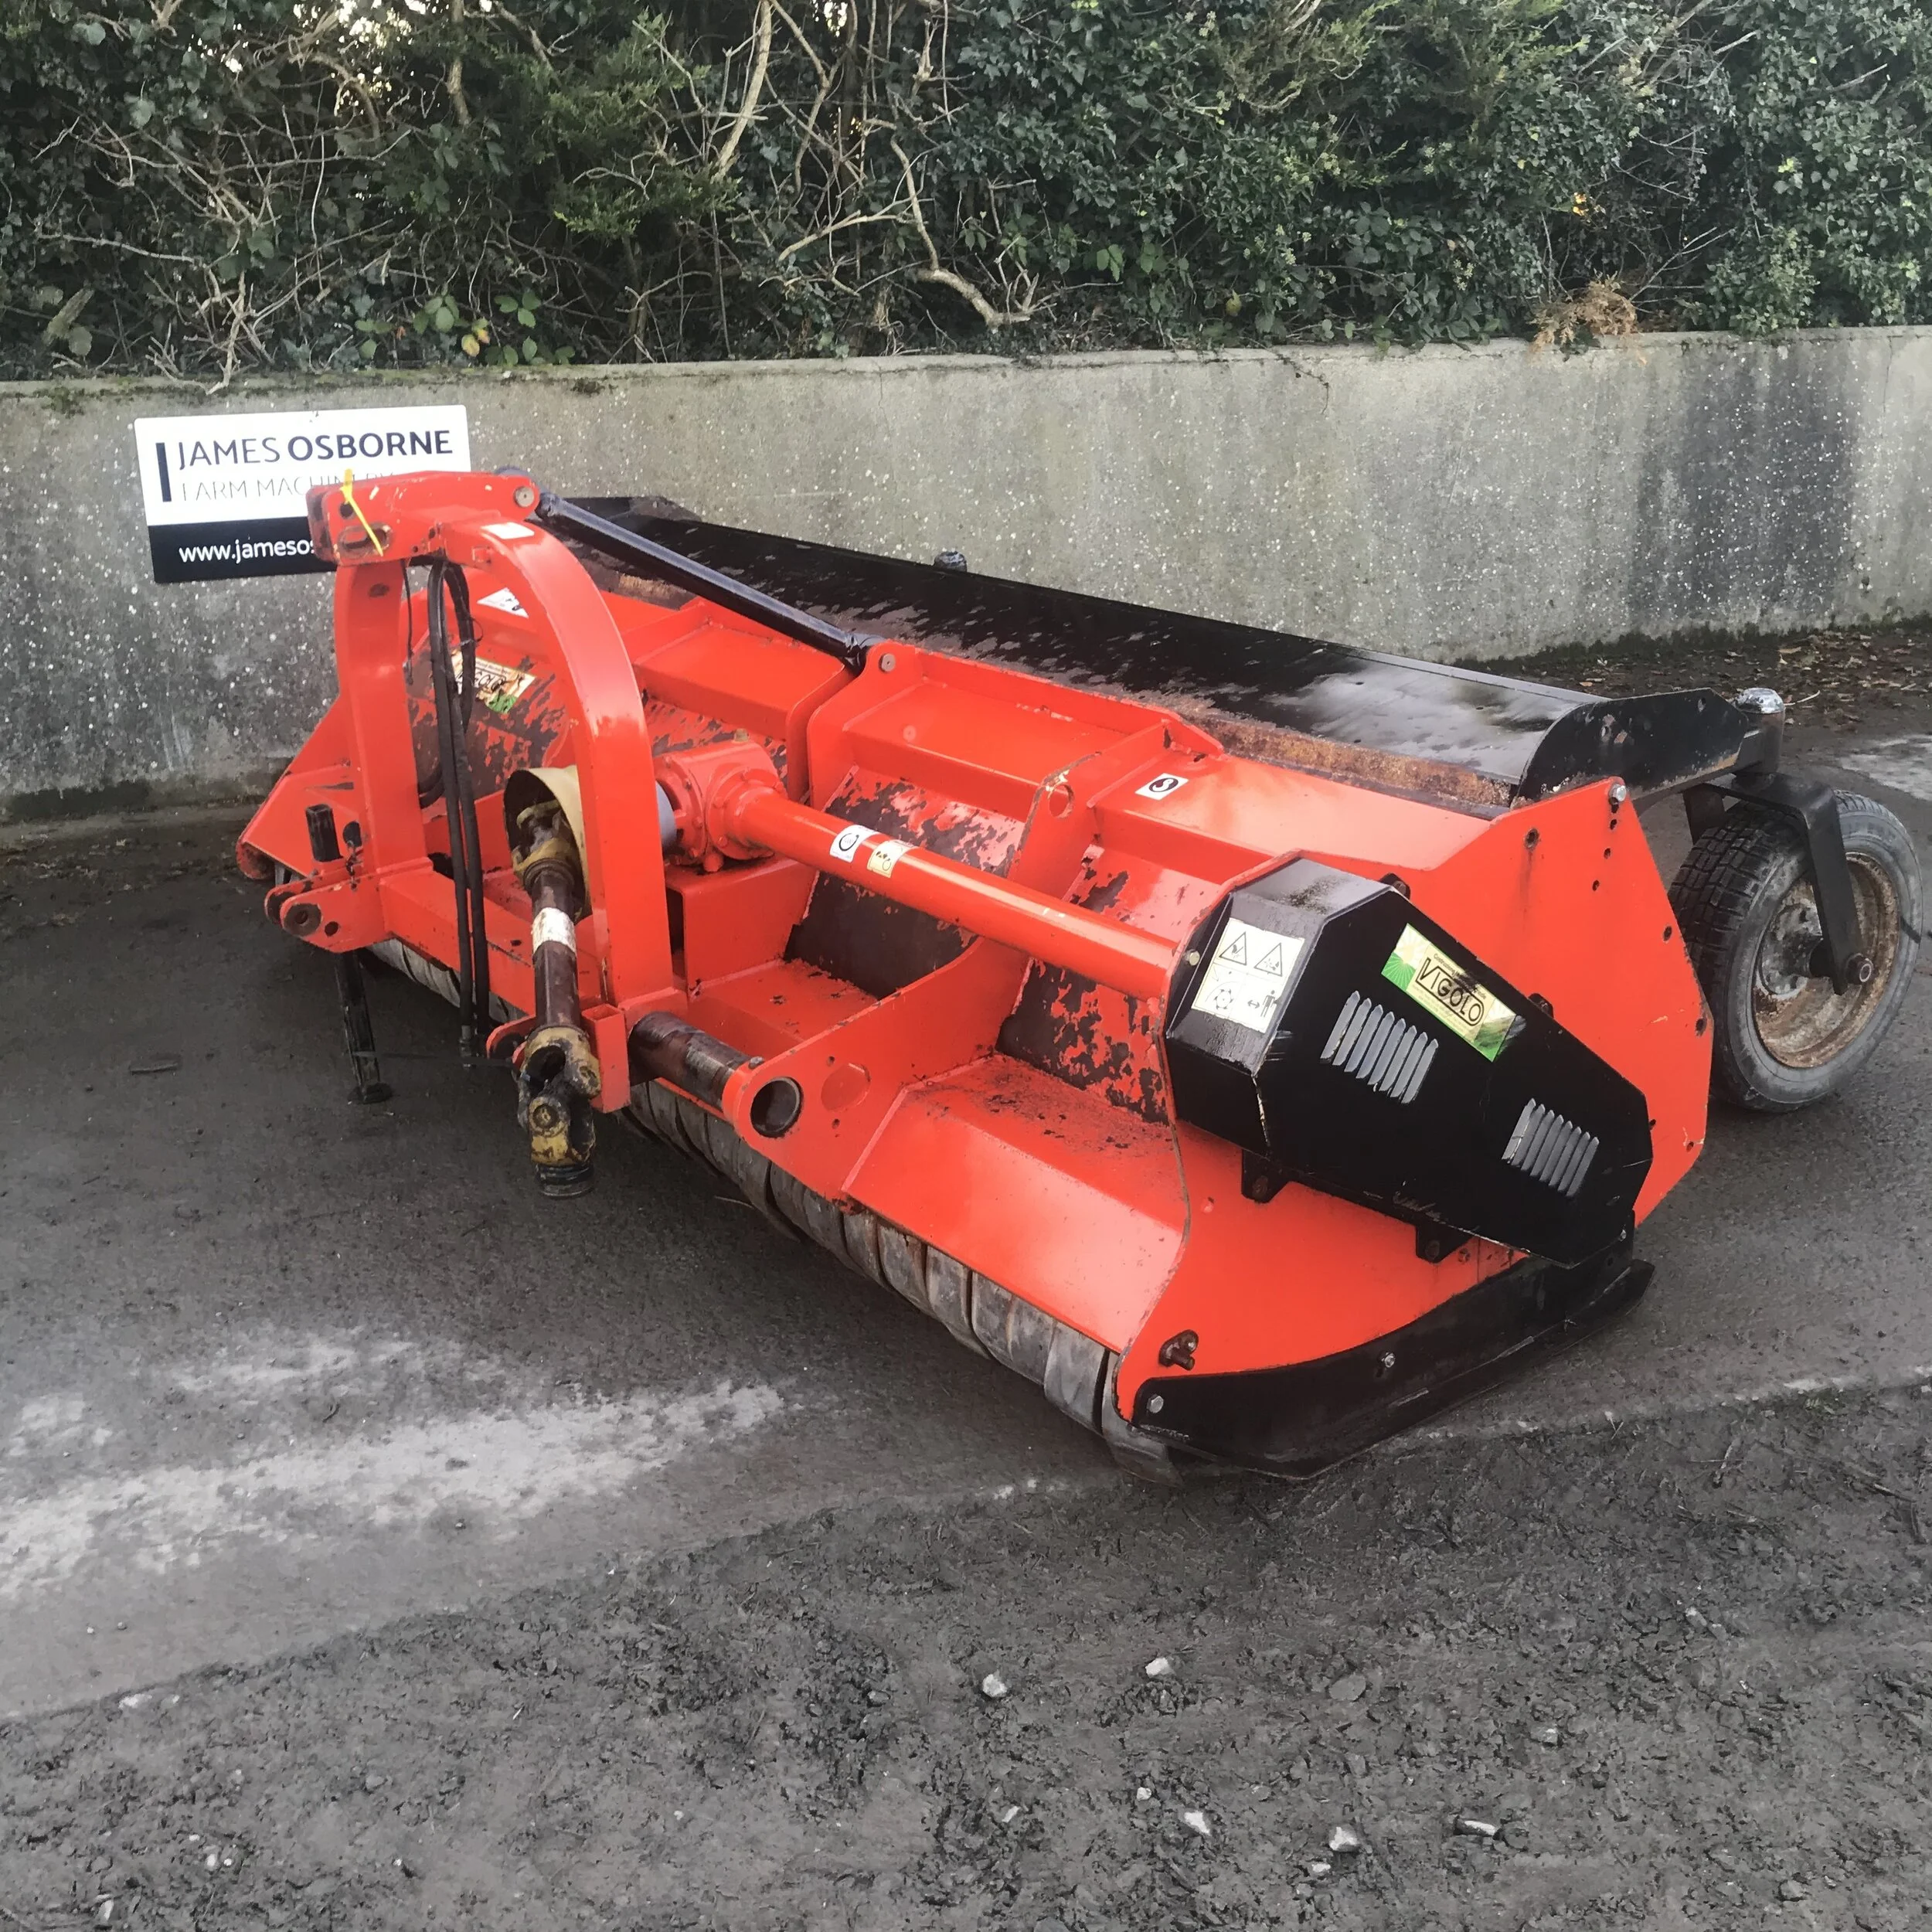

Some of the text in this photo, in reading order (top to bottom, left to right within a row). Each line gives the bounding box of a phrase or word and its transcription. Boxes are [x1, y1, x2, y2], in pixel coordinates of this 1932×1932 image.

[179, 430, 454, 470] JAMES OSBORNE
[1416, 957, 1483, 1025] VIGOLO
